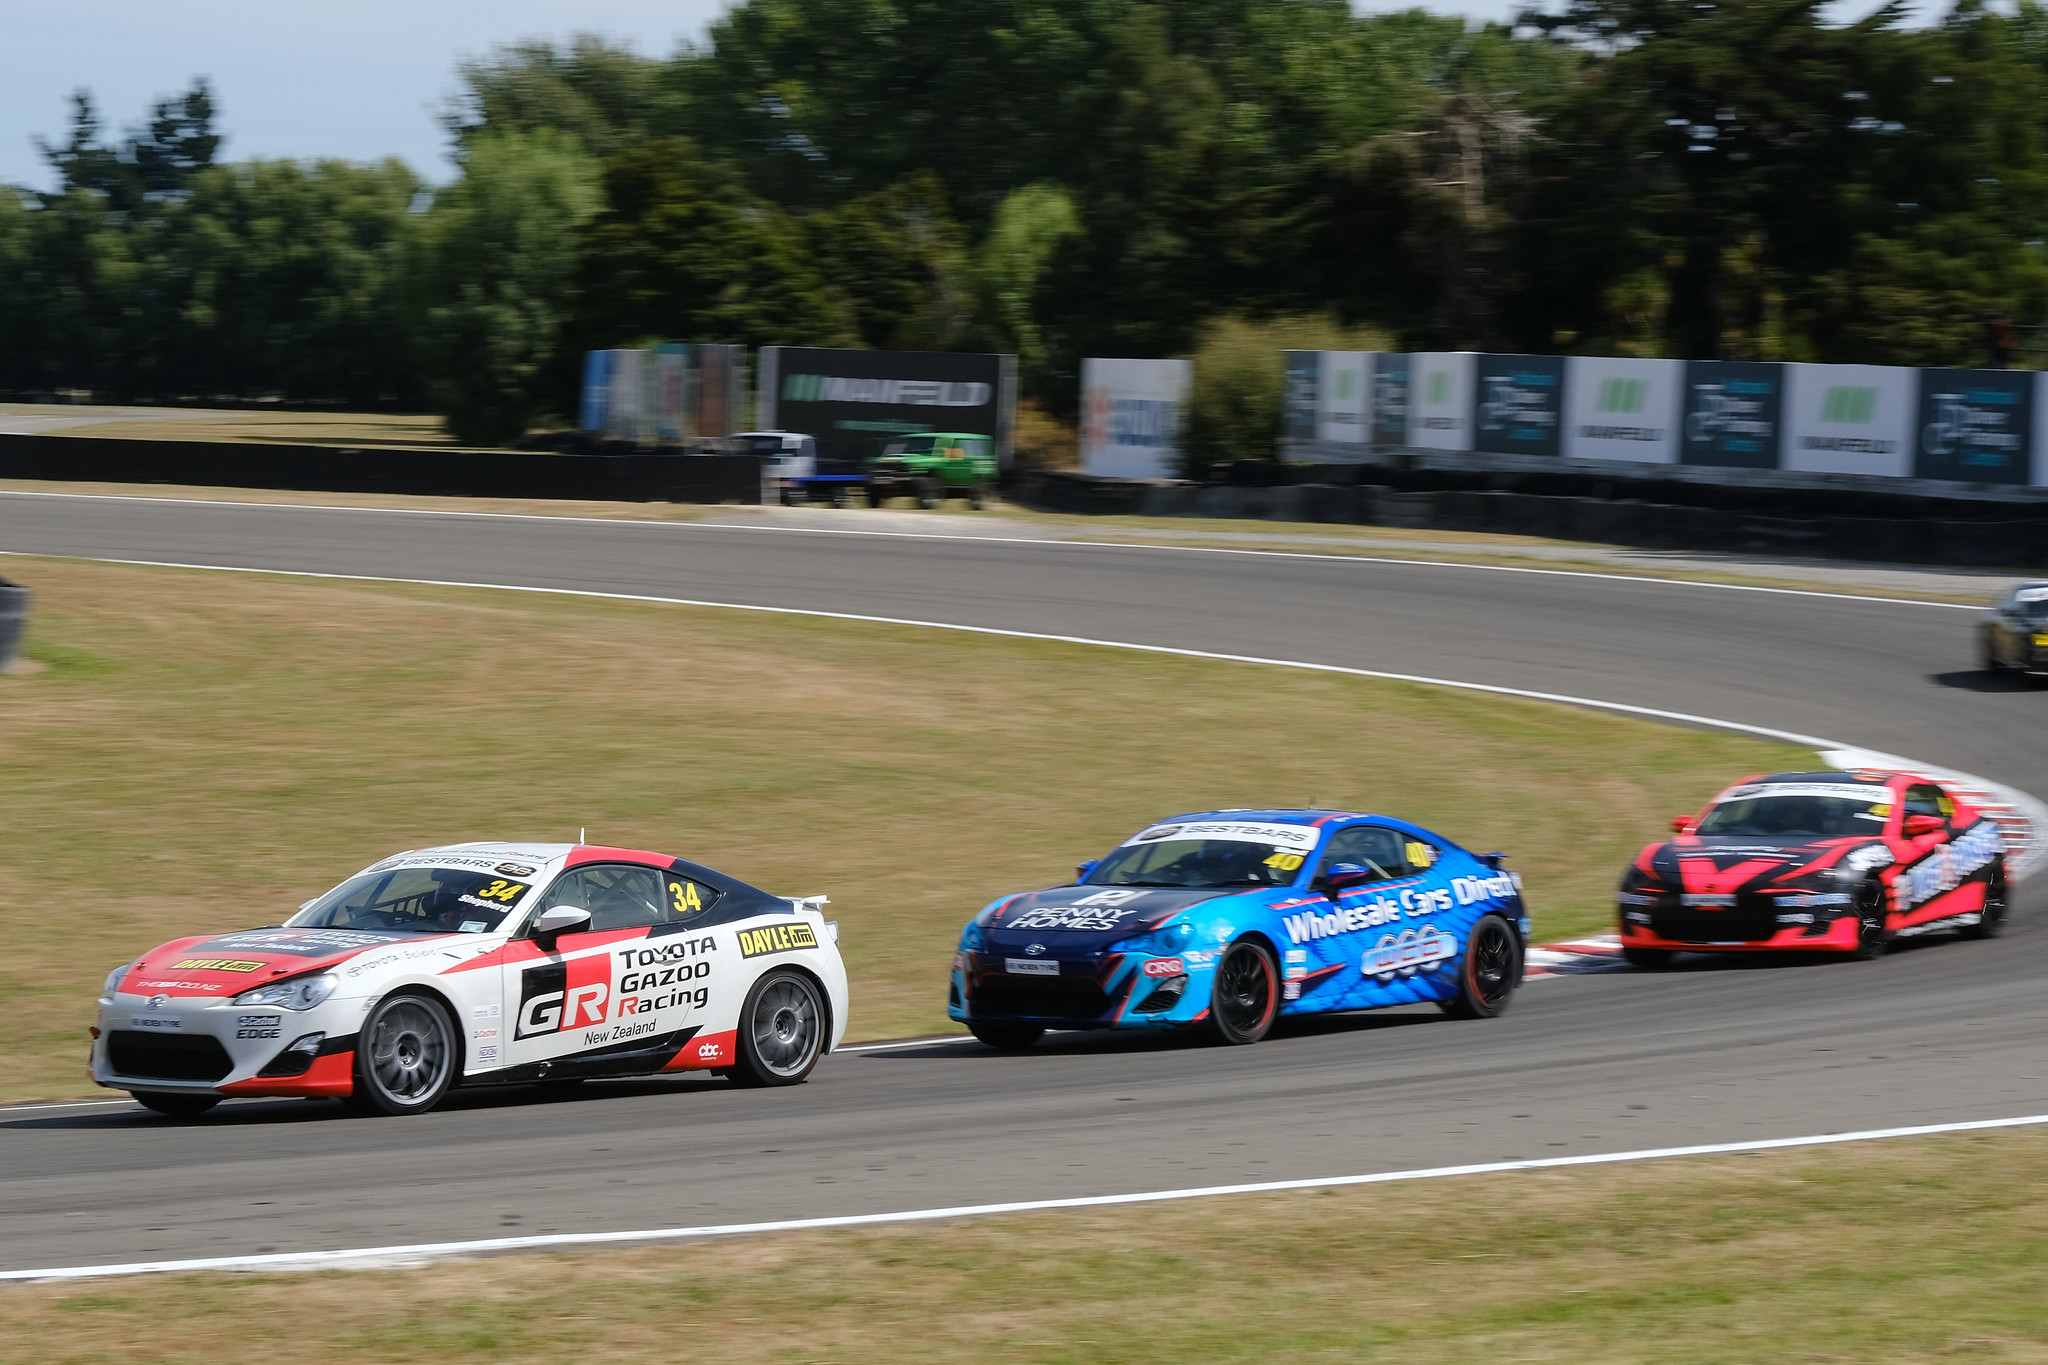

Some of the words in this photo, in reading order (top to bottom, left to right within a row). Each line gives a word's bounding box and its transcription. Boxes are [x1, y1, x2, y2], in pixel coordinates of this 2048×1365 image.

[402, 857, 496, 868] BESTBARS
[1262, 852, 1305, 871] 40
[478, 880, 524, 902] 34
[669, 881, 702, 912] 34
[1005, 916, 1121, 931] HOMES
[1021, 907, 1138, 919] PENNY
[1282, 895, 1401, 944] Wholesale
[1399, 887, 1454, 917] Cars
[618, 935, 718, 970] TOYOTA
[738, 925, 793, 956] DAYLE
[620, 961, 711, 993] GAZOO
[518, 982, 609, 1037] GR
[617, 986, 709, 1018] Racing
[236, 1028, 282, 1039] EDGE
[584, 1029, 611, 1046] New
[612, 1018, 657, 1045] Zealand
